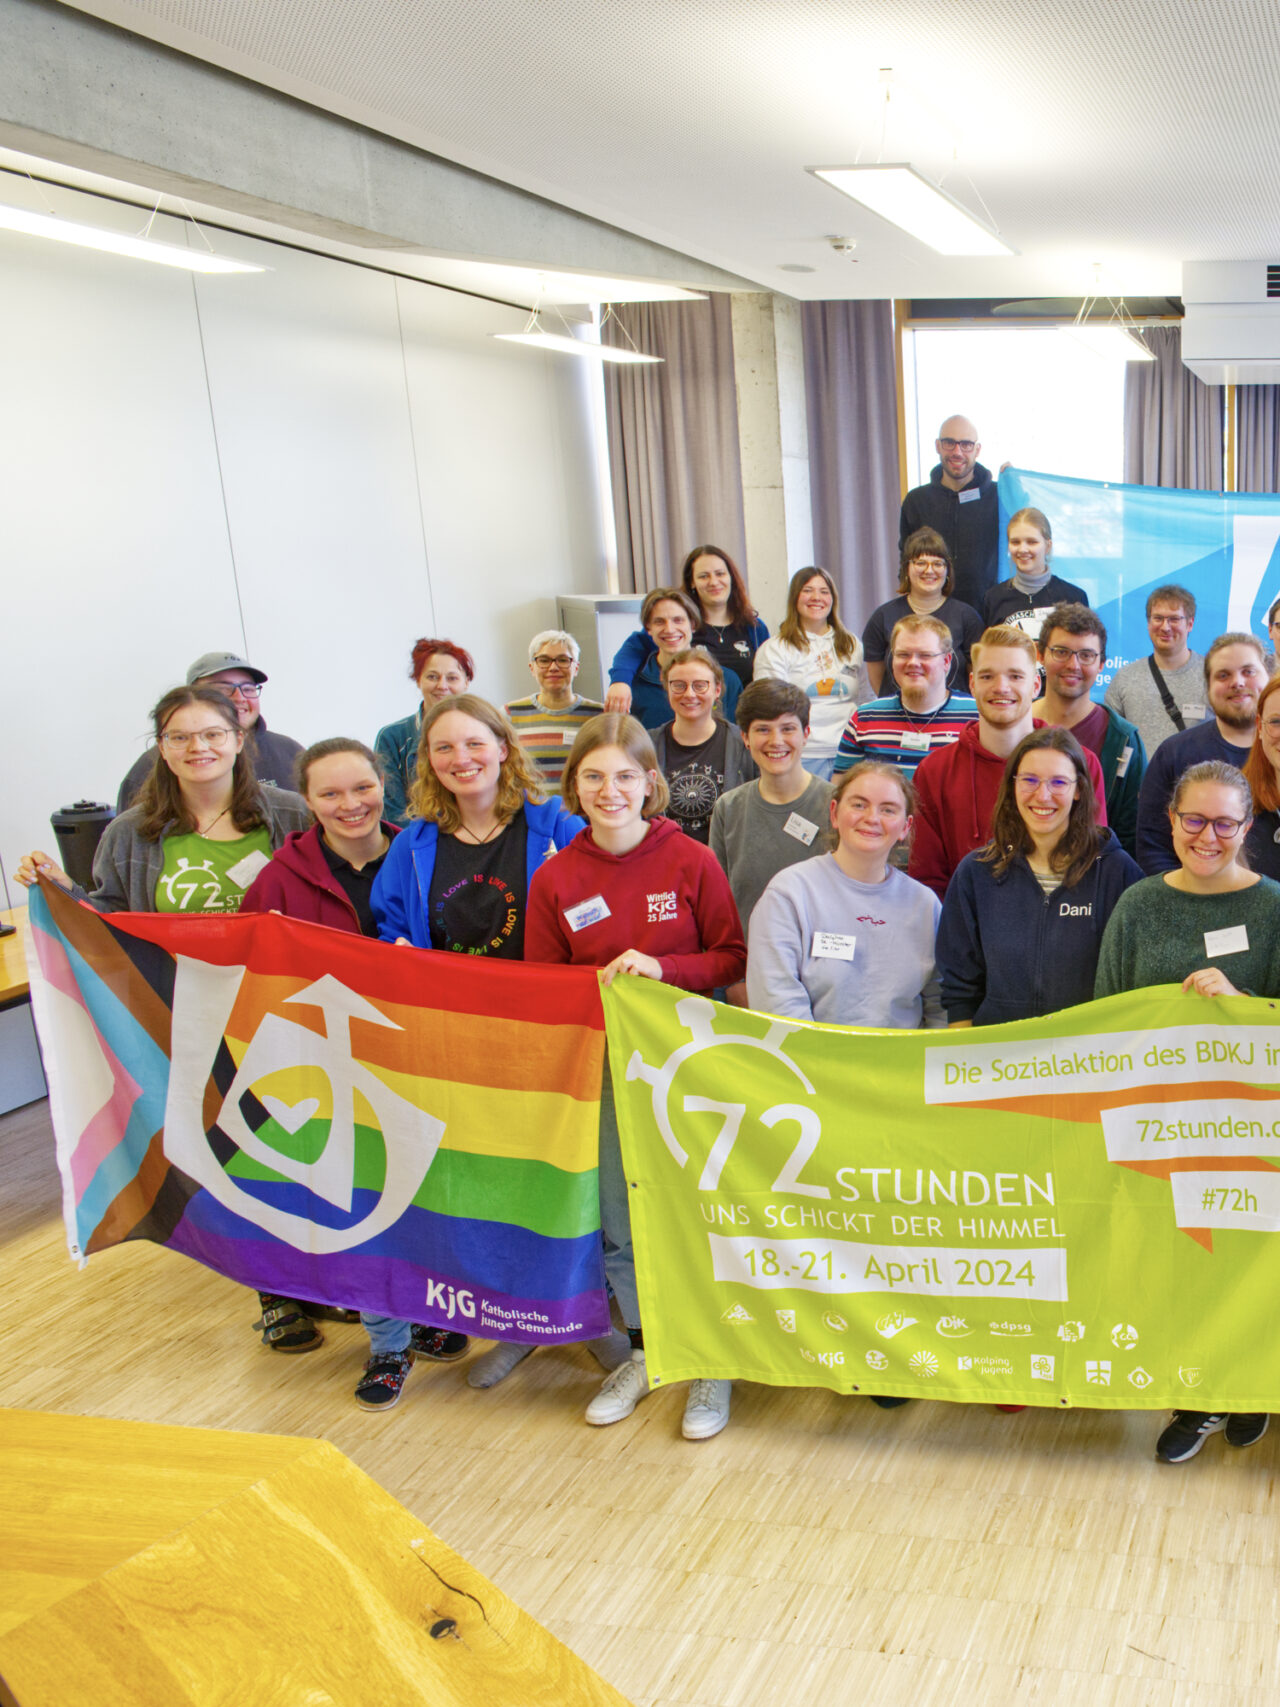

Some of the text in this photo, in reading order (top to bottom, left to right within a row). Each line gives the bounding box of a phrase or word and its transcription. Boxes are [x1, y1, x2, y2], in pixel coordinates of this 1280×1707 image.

[473, 874, 484, 883] IS
[175, 881, 224, 910] 72
[646, 891, 677, 903] Wittlich
[648, 900, 677, 914] KjG
[648, 911, 678, 923] 25 Jahre
[1059, 902, 1093, 917] Dani
[943, 1062, 982, 1085] Die
[991, 1049, 1133, 1082] Sozialaktion
[1143, 1044, 1186, 1067] des
[1196, 1040, 1255, 1066] BDKJ
[683, 1095, 1056, 1207] 72 STUNDEN
[1201, 1187, 1258, 1213] #72h
[700, 1202, 1067, 1239] UNS SCHICKT DER HIMMEL
[743, 1248, 1037, 1288] 18.-21. April 2024
[425, 1278, 477, 1320] KjG
[480, 1298, 550, 1323] Katholische
[480, 1312, 584, 1335] junge Gemeinde
[1000, 1322, 1032, 1333] dpsg
[817, 1351, 845, 1369] KjG
[973, 1356, 1010, 1368] Kolping
